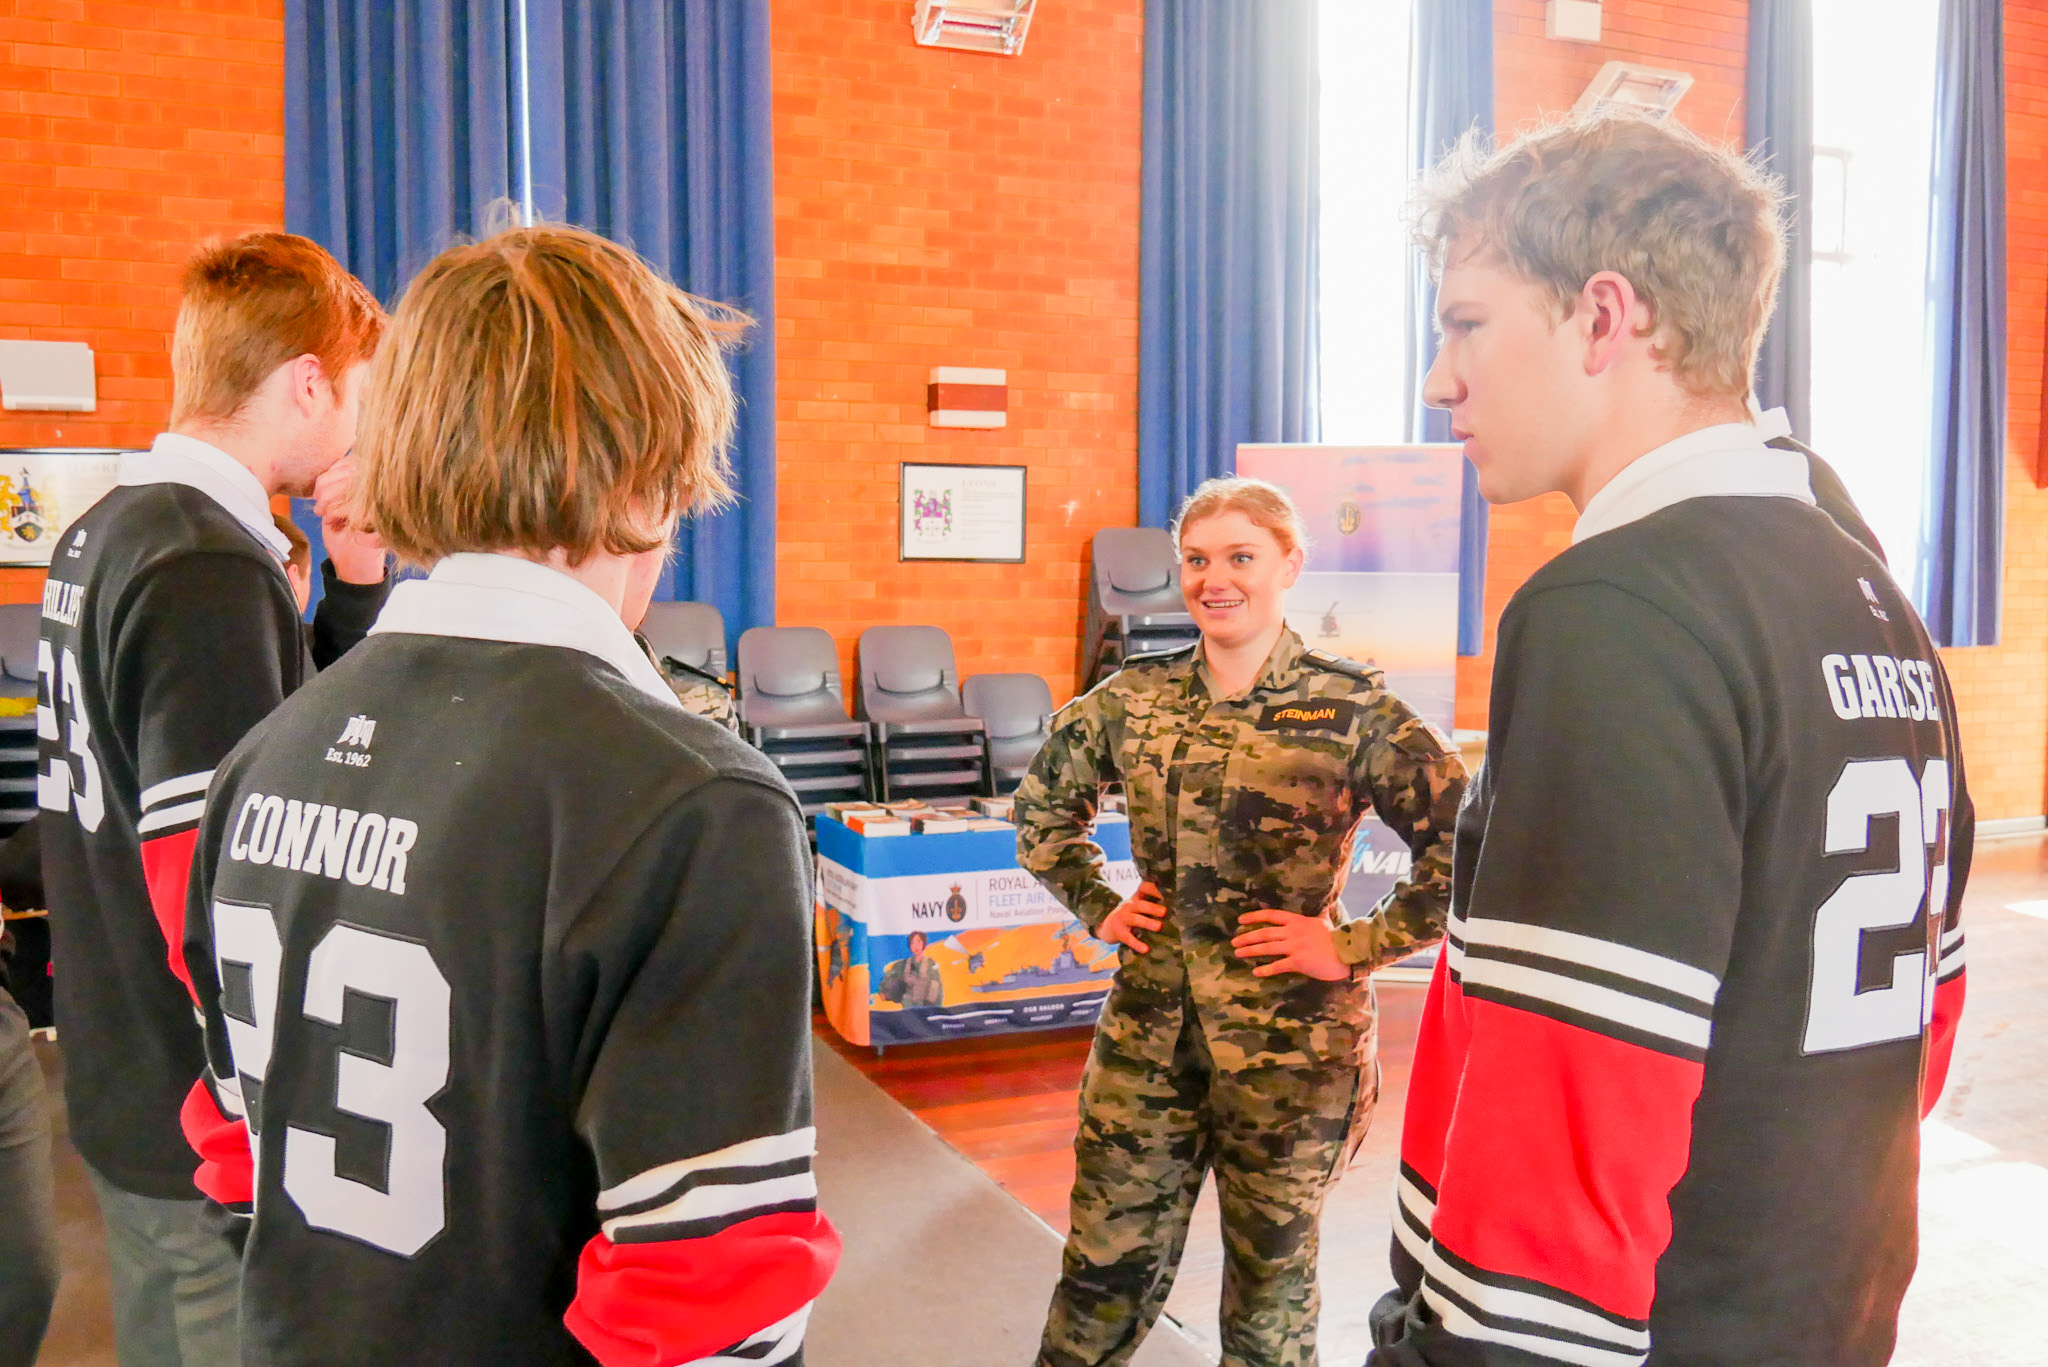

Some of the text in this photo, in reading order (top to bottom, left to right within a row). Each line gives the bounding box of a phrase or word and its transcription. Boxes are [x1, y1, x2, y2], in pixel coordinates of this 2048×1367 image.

[1272, 708, 1337, 722] STEINMAN
[37, 639, 105, 833] 23
[345, 751, 373, 768] 1962
[230, 792, 419, 896] CONNOR
[989, 876, 1028, 891] ROYAL
[989, 893, 1022, 907] FLEET
[1026, 891, 1045, 905] AIR
[912, 901, 945, 920] NAVY
